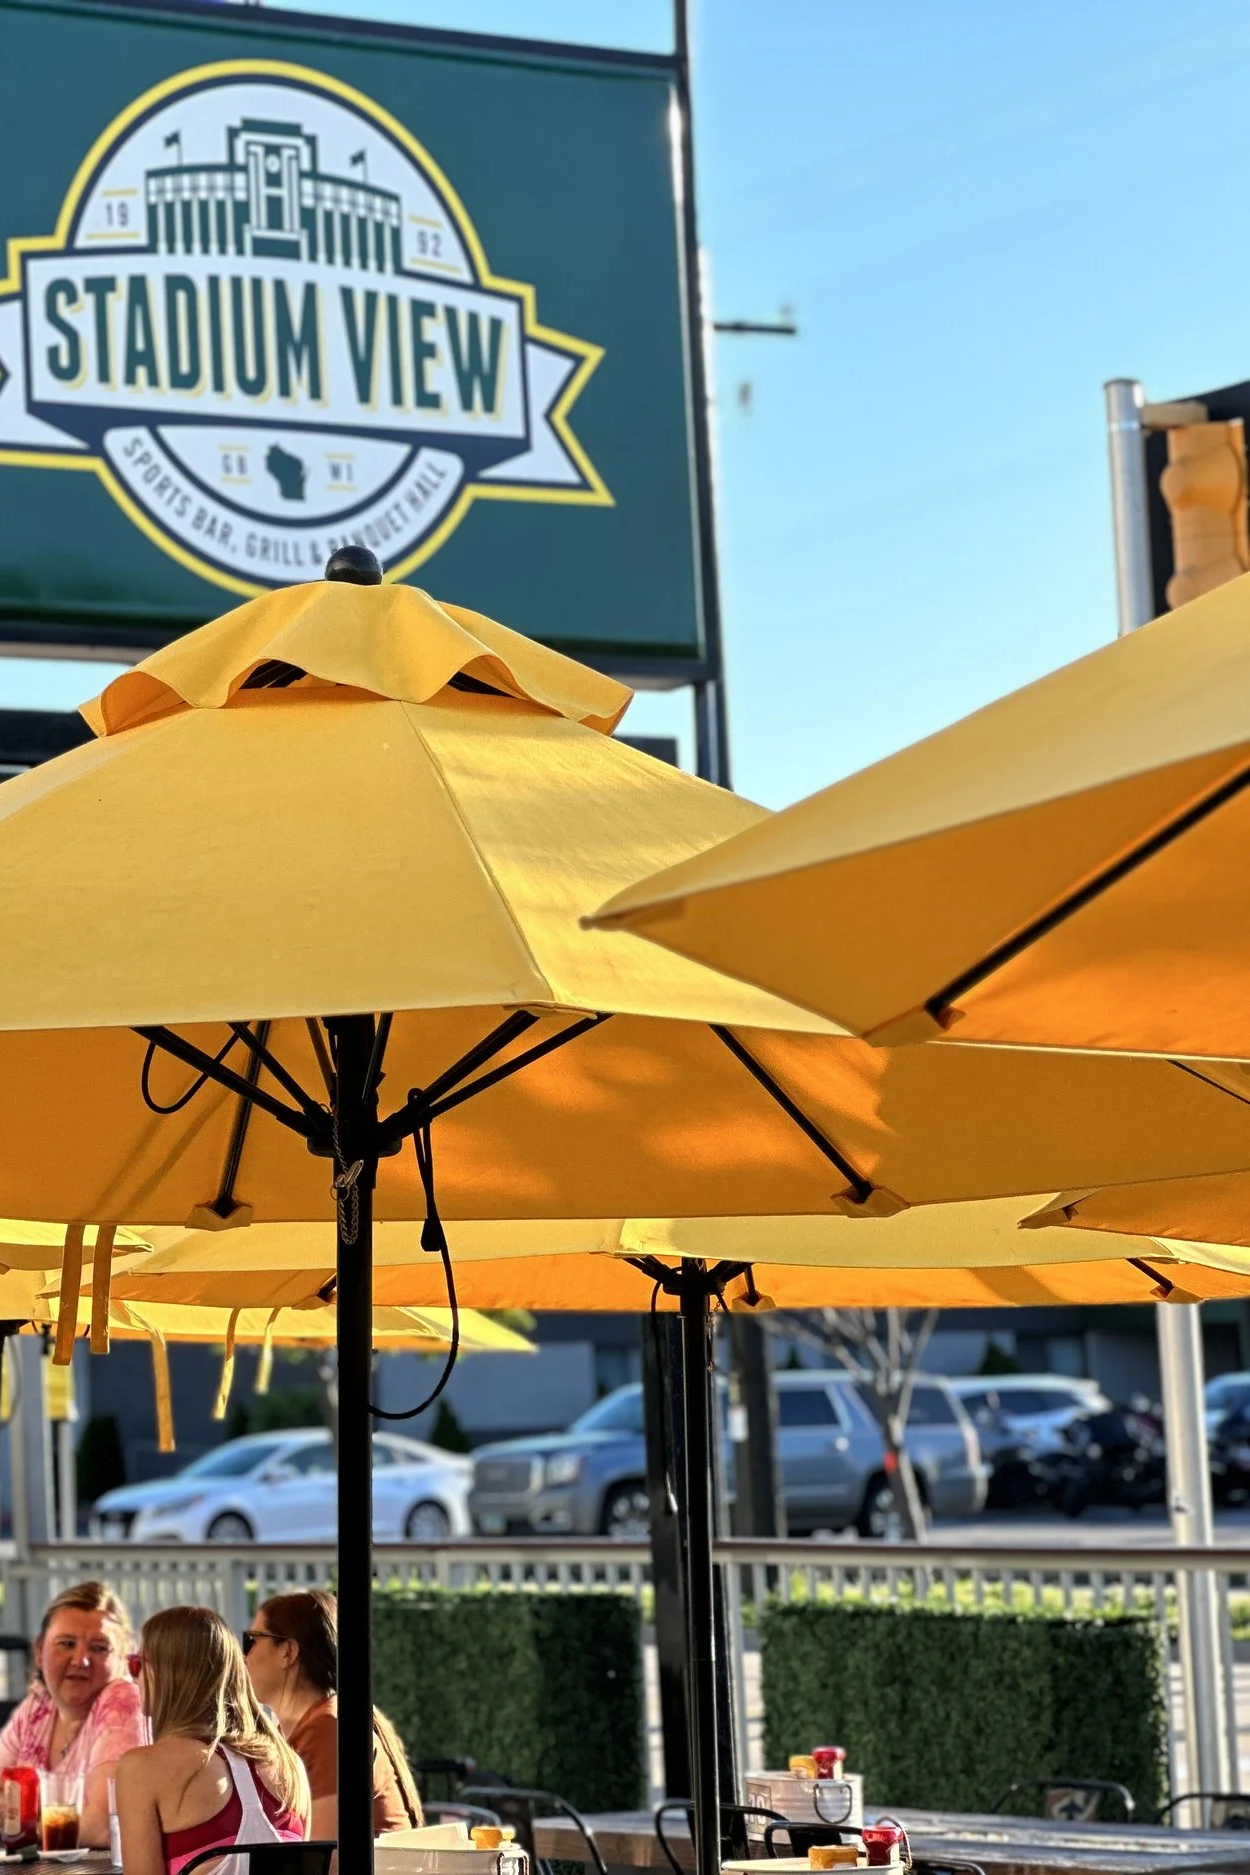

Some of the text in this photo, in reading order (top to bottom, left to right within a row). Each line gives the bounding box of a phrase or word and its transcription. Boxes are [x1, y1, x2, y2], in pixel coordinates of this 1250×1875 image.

[104, 200, 130, 228] 19
[44, 272, 507, 417] STADIUM VIEW
[123, 436, 192, 518] SPORTS
[245, 532, 304, 567] GRILL
[309, 539, 323, 566] &
[403, 461, 449, 514] HALL
